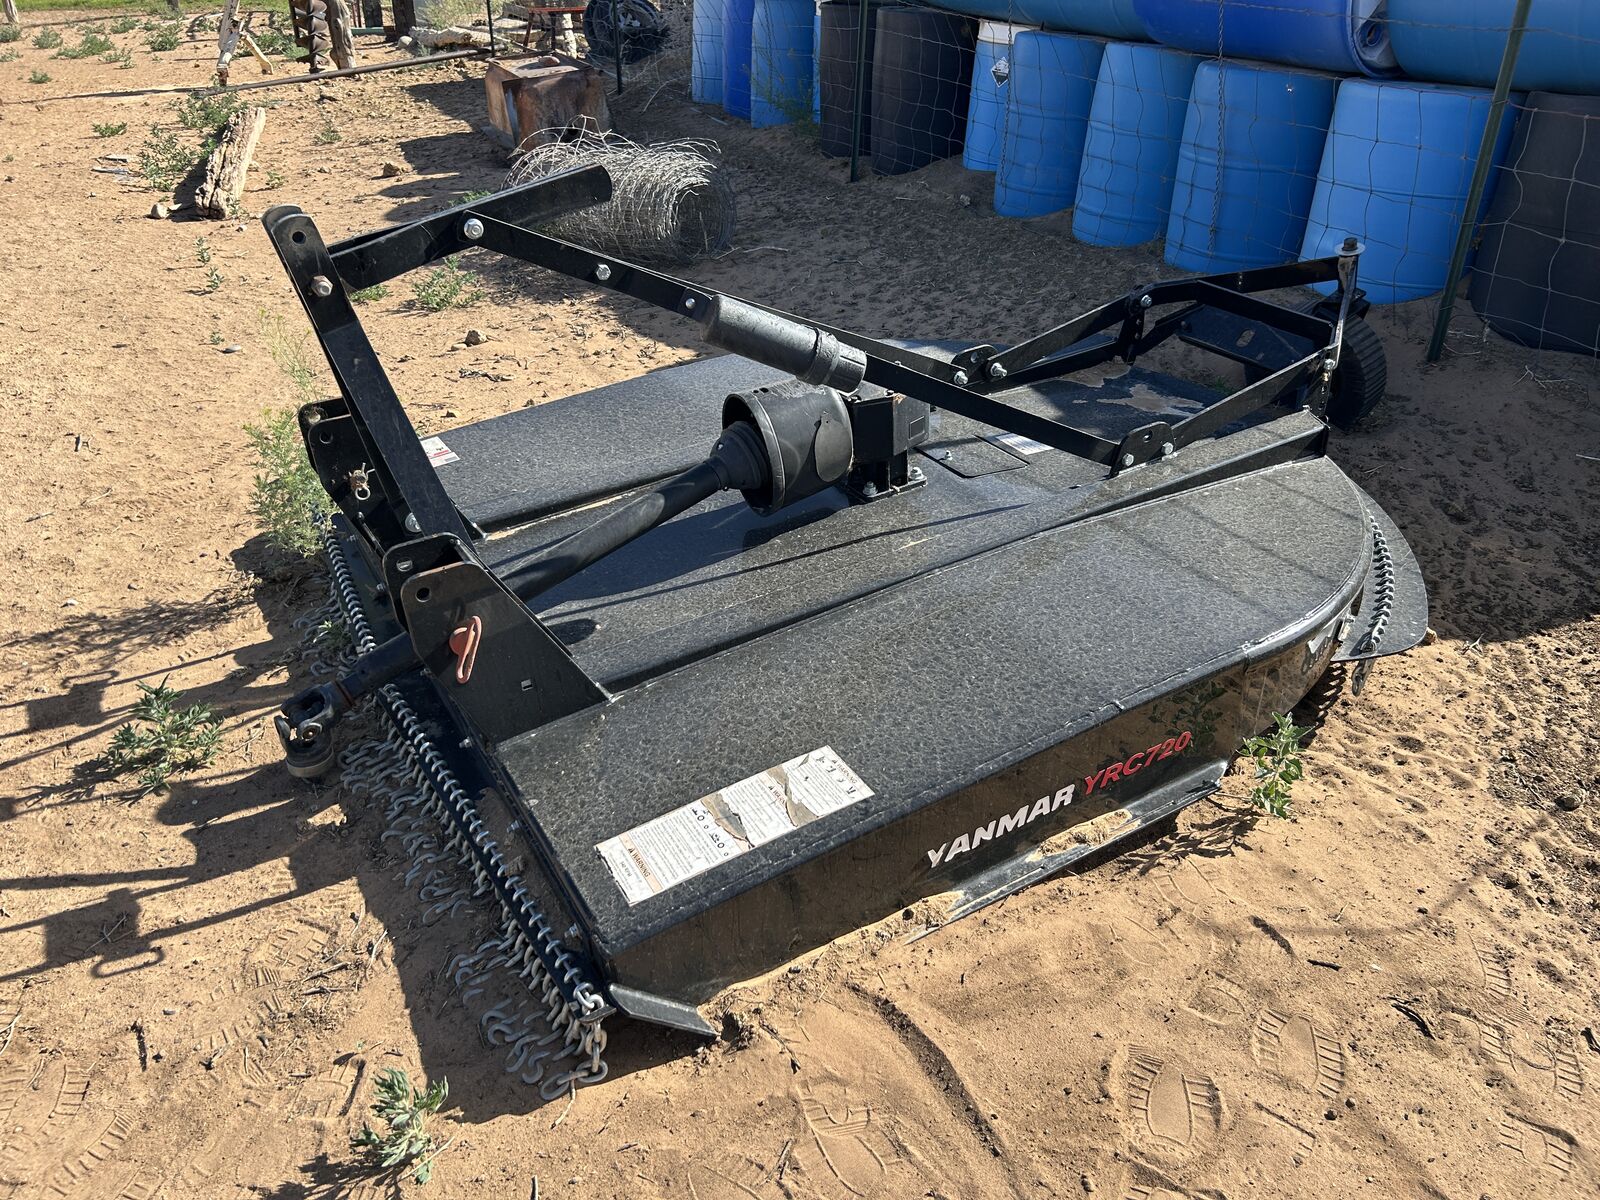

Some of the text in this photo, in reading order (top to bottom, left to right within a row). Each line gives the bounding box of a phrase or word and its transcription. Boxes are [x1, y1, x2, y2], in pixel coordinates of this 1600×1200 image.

[927, 783, 1076, 868] YANMAR
[1083, 731, 1193, 795] YRC720
[632, 852, 651, 878] WARNING
